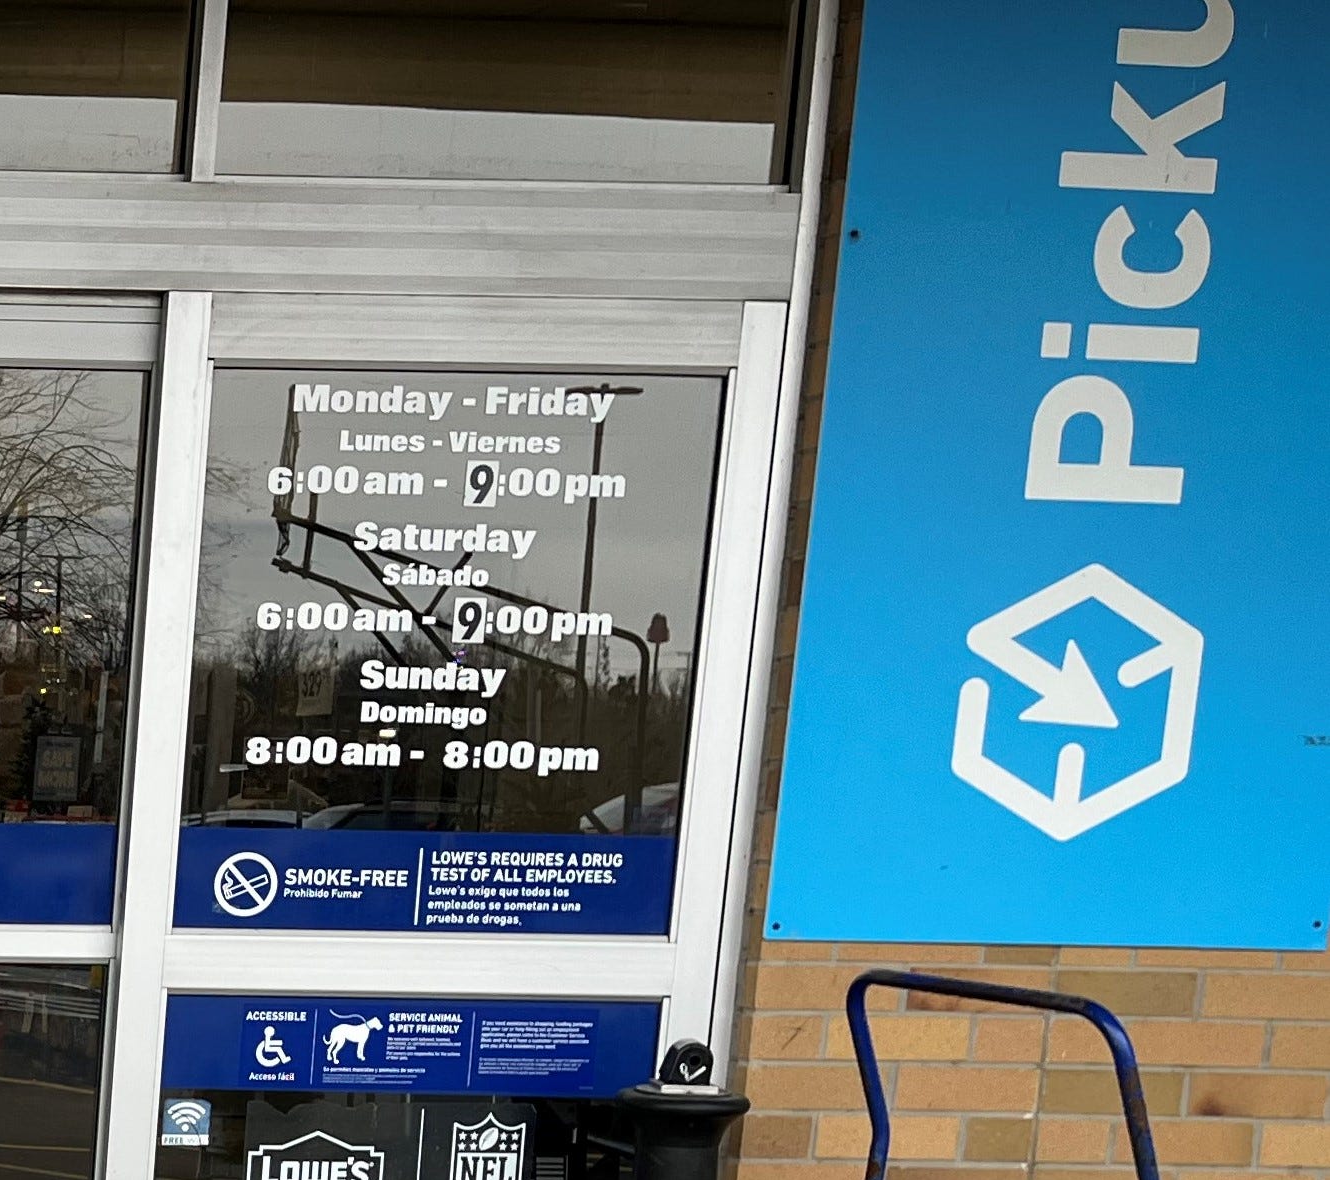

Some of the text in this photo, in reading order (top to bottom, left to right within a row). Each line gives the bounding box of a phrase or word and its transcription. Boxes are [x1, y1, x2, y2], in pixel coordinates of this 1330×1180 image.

[293, 384, 453, 422] Monday
[485, 387, 616, 423] Friday
[339, 430, 425, 453] Lunes
[450, 431, 561, 455] Viernes
[353, 521, 537, 559] Saturday
[382, 564, 490, 588] Sábado
[360, 660, 506, 699] Sunday
[360, 701, 488, 729] Domingo
[431, 850, 623, 868] LOWE'S REQUIRES A DRUG
[284, 868, 409, 889] SMOKE-FREE
[431, 867, 617, 884] TEST OF ALL EMPLOYEES.
[283, 888, 363, 900] Prohibido Fumar
[428, 885, 570, 900] Lowe's exige que todos los
[427, 900, 581, 913] empleados se sometan a una
[426, 912, 523, 927] prueba de drogas.
[246, 1011, 307, 1022] ACCESSIBLE
[388, 1012, 463, 1023] SERVICE ANIMAL
[397, 1024, 415, 1033] PET
[416, 1024, 460, 1034] FRIENDLY
[248, 1072, 276, 1081] Acceso
